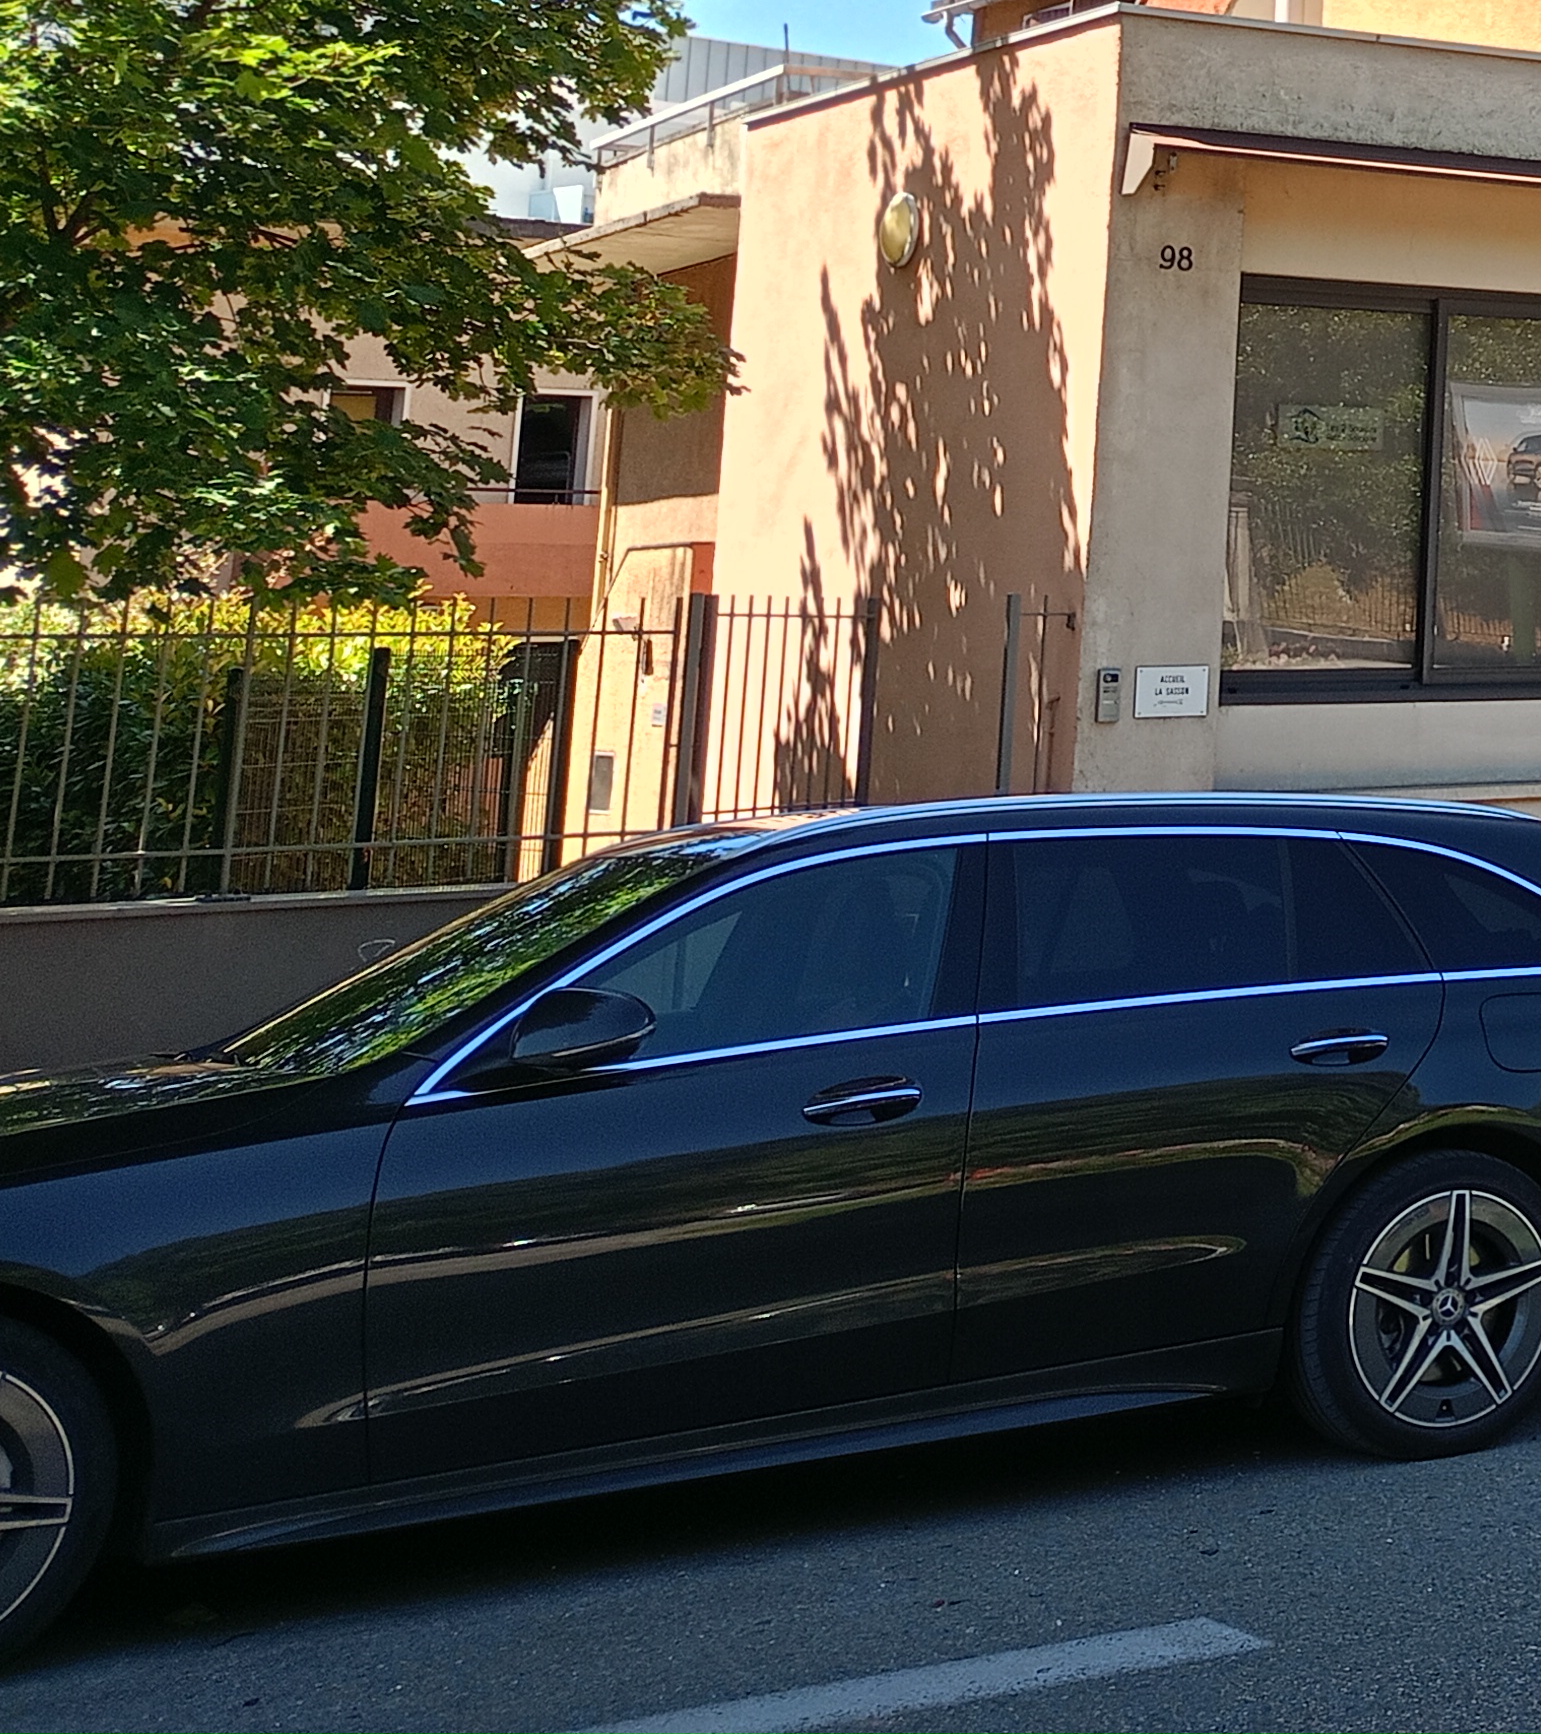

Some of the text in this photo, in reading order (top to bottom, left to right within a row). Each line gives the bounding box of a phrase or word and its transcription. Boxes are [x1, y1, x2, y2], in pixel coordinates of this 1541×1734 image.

[1159, 244, 1194, 272] 98
[1160, 674, 1186, 684] ACCUEIL
[1154, 687, 1163, 696] LA
